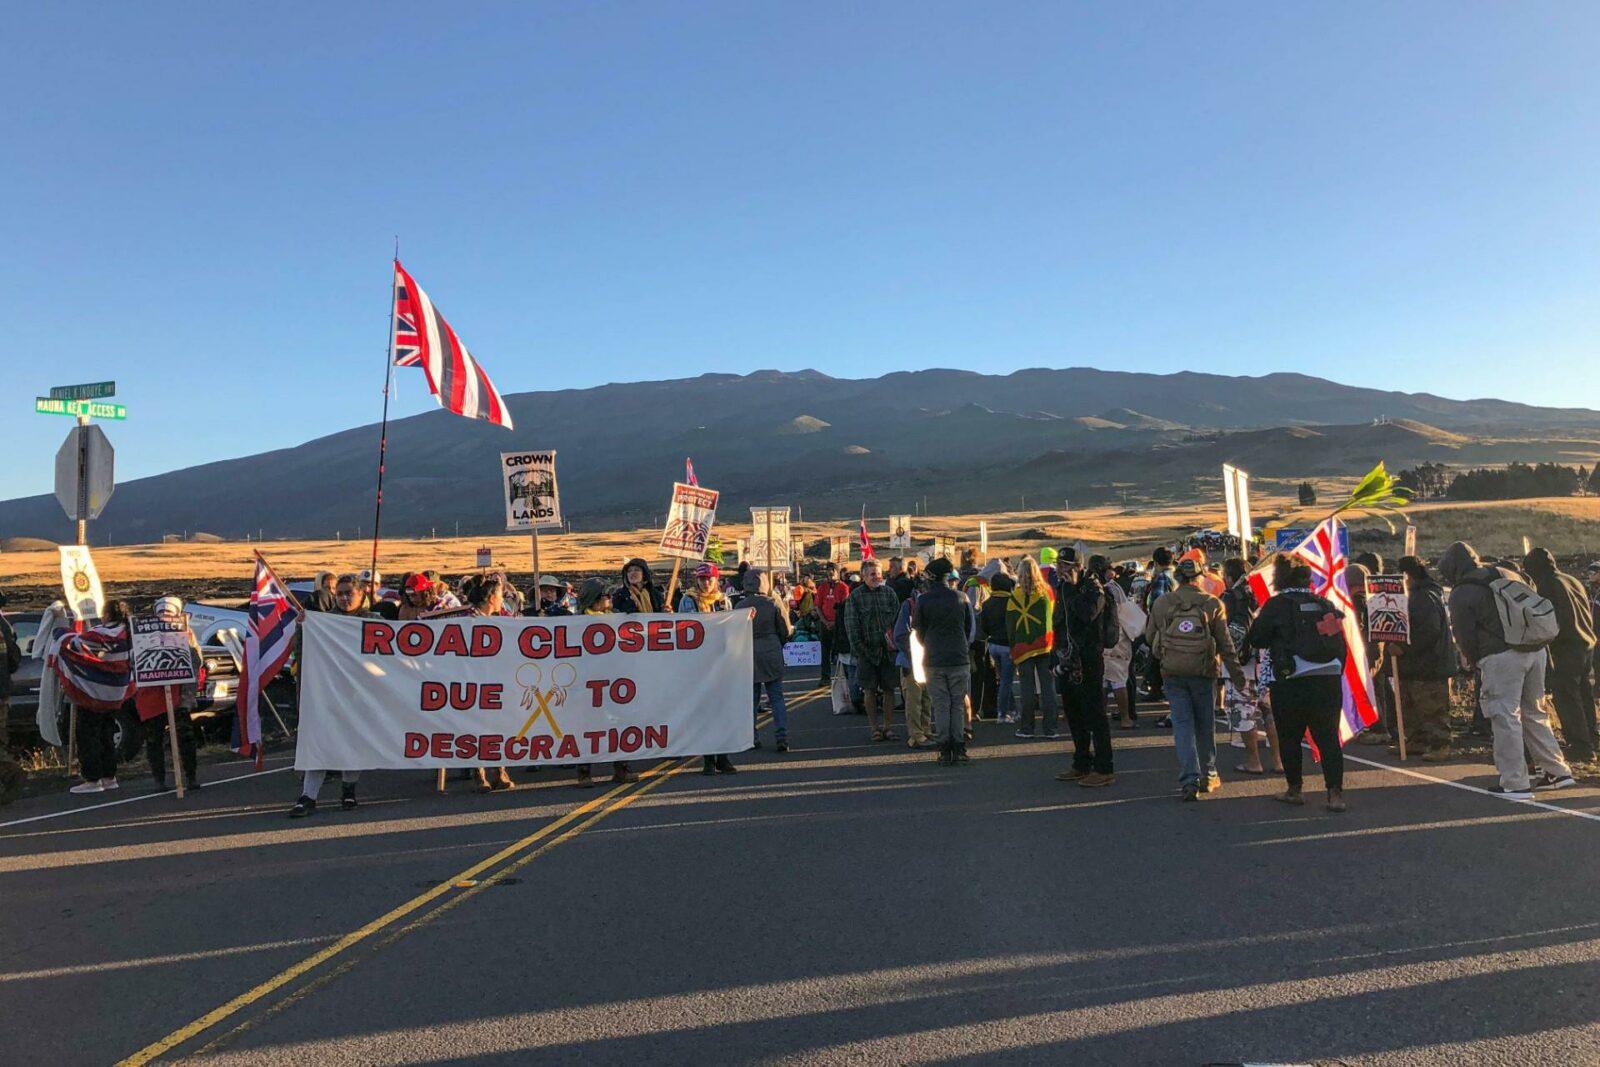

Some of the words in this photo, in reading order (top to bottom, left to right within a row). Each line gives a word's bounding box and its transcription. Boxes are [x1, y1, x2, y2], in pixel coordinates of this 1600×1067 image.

[37, 399, 65, 414] MAUNA
[506, 454, 553, 467] CROWN
[677, 494, 712, 508] PROTECT
[513, 507, 554, 519] LANDS
[137, 622, 183, 633] PROTECT
[361, 621, 502, 657] ROAD
[518, 619, 705, 658] CLOSED
[140, 670, 190, 680] MAUNAKEA
[420, 681, 503, 711] DUE
[586, 678, 636, 708] TO
[403, 725, 669, 761] DESECRATION
